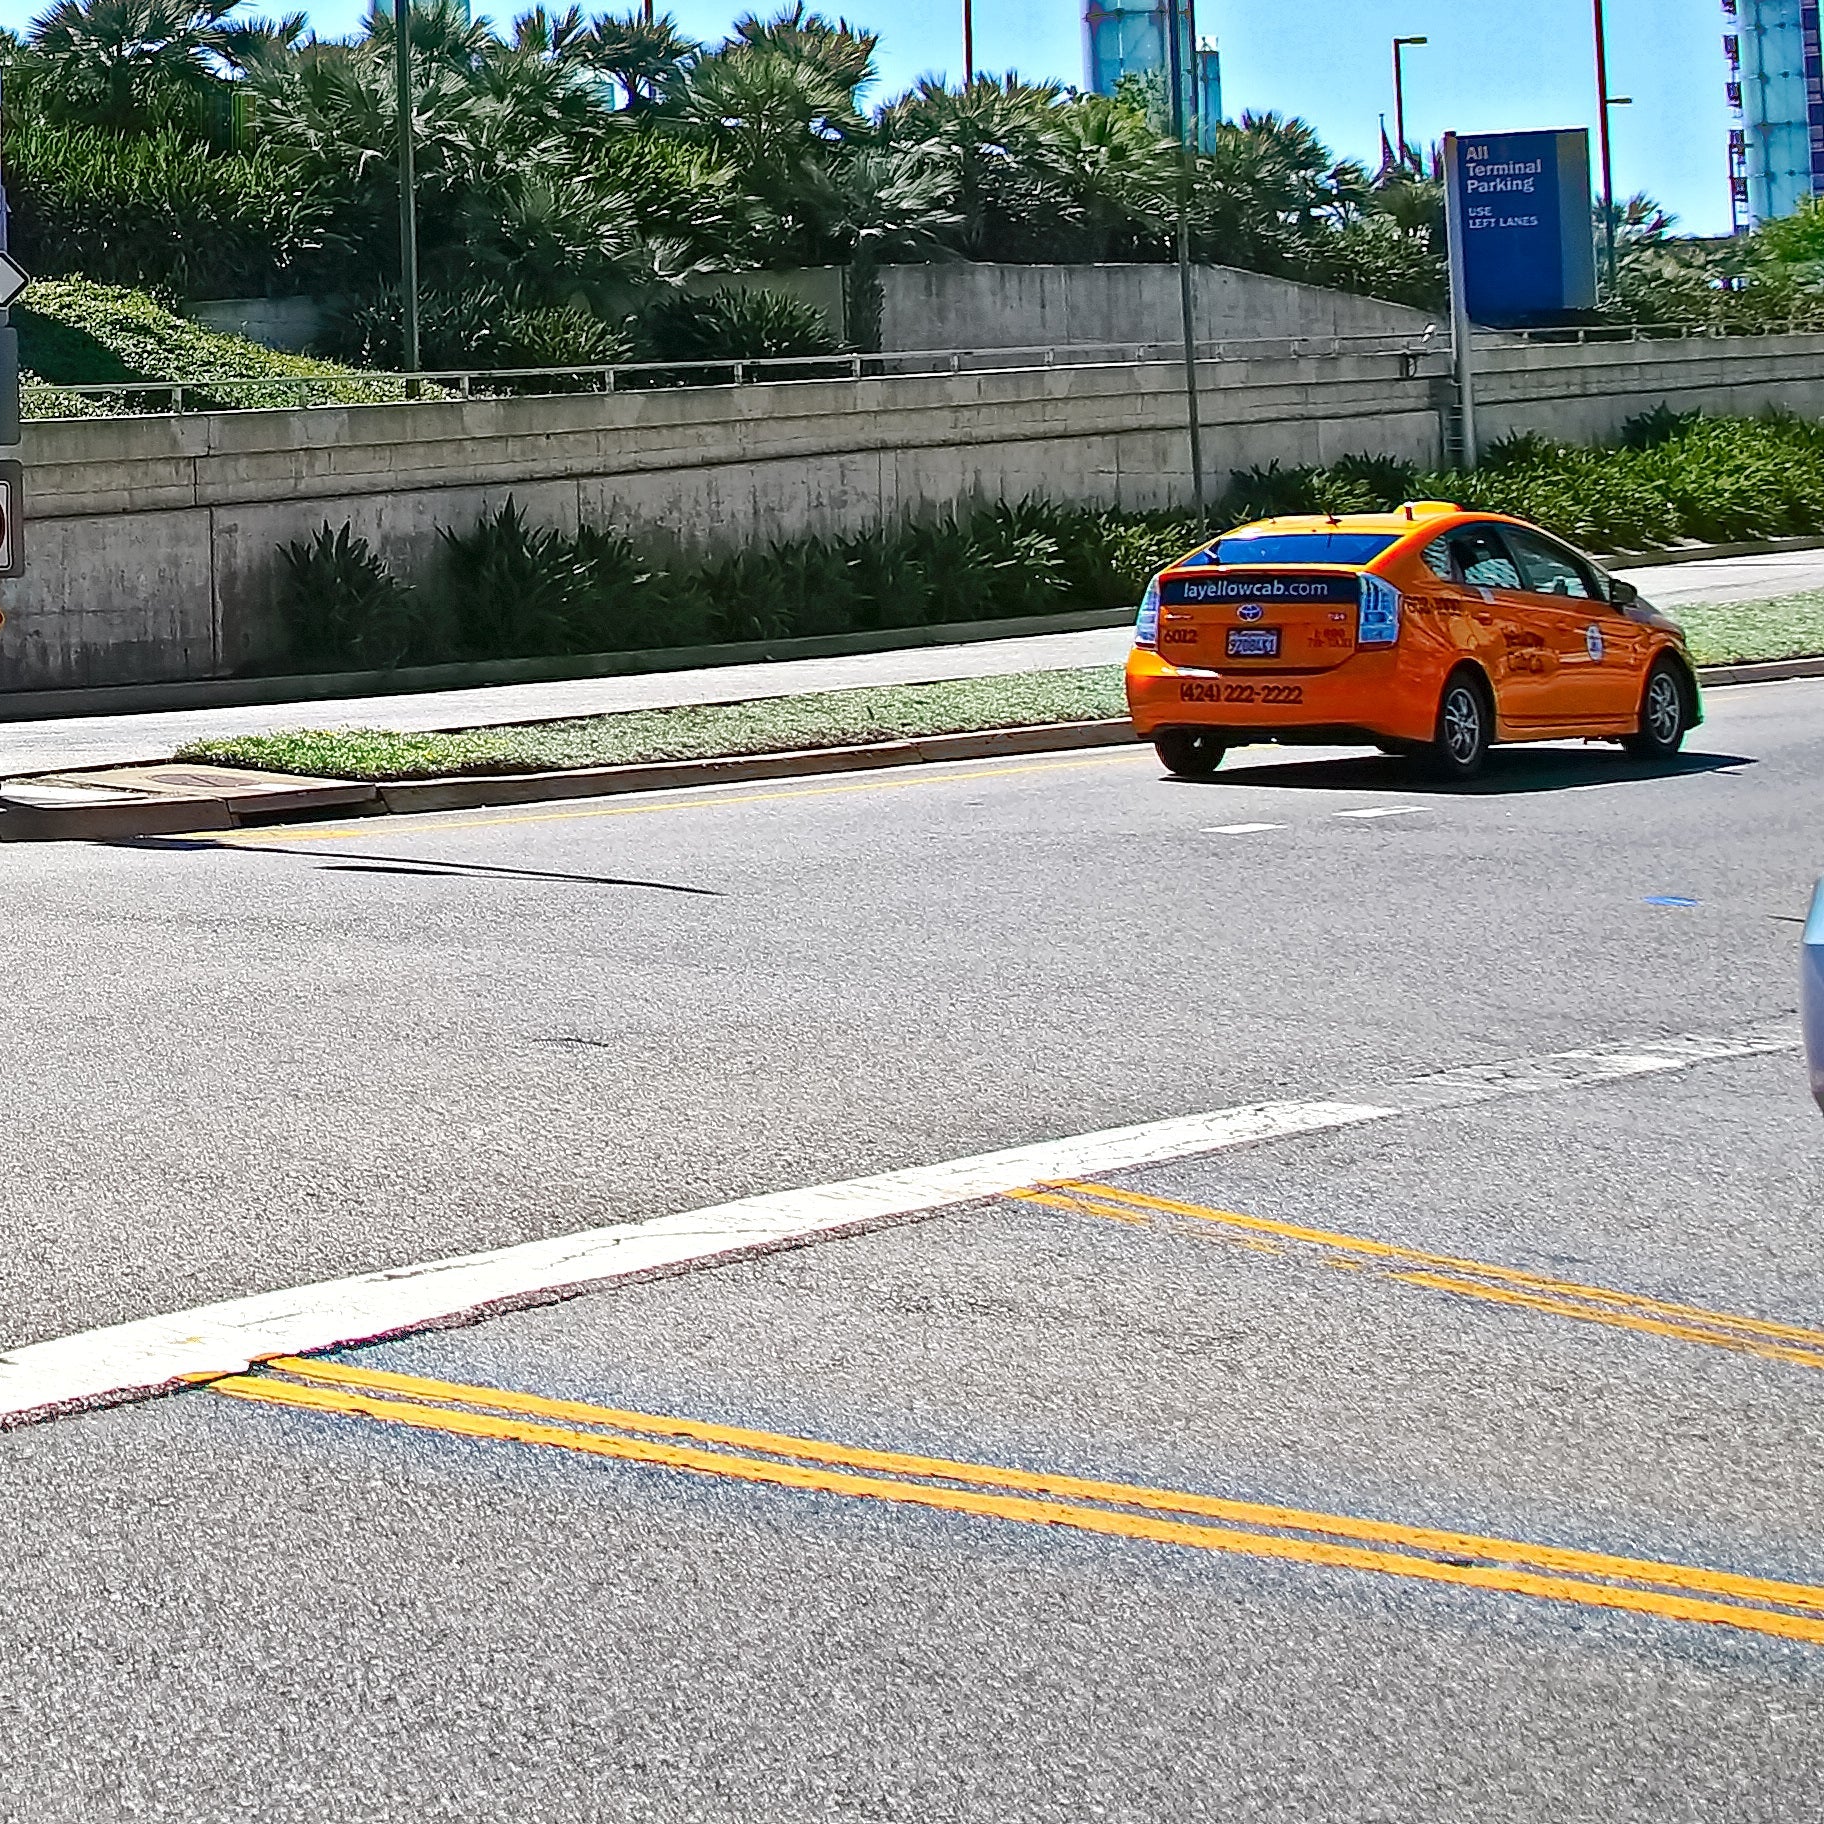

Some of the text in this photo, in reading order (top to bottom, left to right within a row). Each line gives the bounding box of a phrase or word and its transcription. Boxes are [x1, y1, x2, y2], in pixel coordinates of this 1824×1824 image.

[1466, 145, 1489, 161] All
[1466, 159, 1542, 177] Terminal
[1467, 177, 1534, 194] Parking
[1468, 206, 1493, 217] USE
[1469, 215, 1539, 229] LEFT LANES
[1183, 580, 1329, 601] layellowcab.com
[1180, 682, 1303, 704] (424) 222-2222
